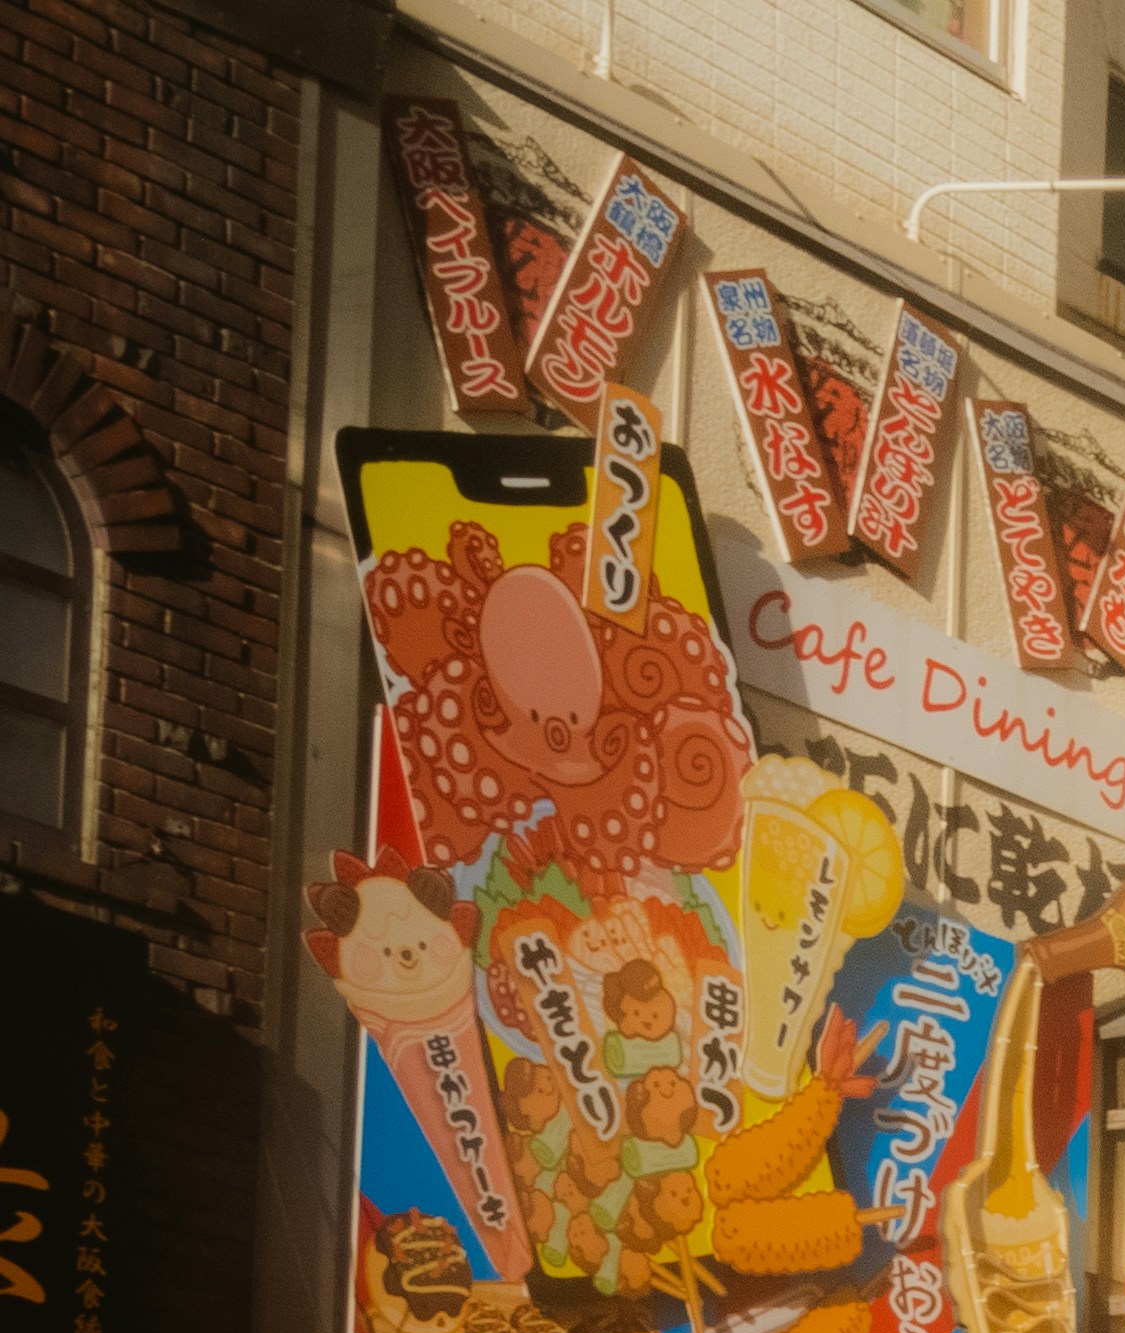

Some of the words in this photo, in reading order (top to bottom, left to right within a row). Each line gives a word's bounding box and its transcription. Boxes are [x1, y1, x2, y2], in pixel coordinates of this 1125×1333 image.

[604, 397, 658, 614] おつくり
[742, 353, 832, 546] 水なす
[747, 590, 896, 696] Cafe
[993, 474, 1064, 662] どてやき
[511, 929, 622, 1141] やきとり
[775, 857, 836, 1050] レモンサワー
[425, 1032, 511, 1231] 串かつケーキ
[695, 973, 743, 1132] 串かつ
